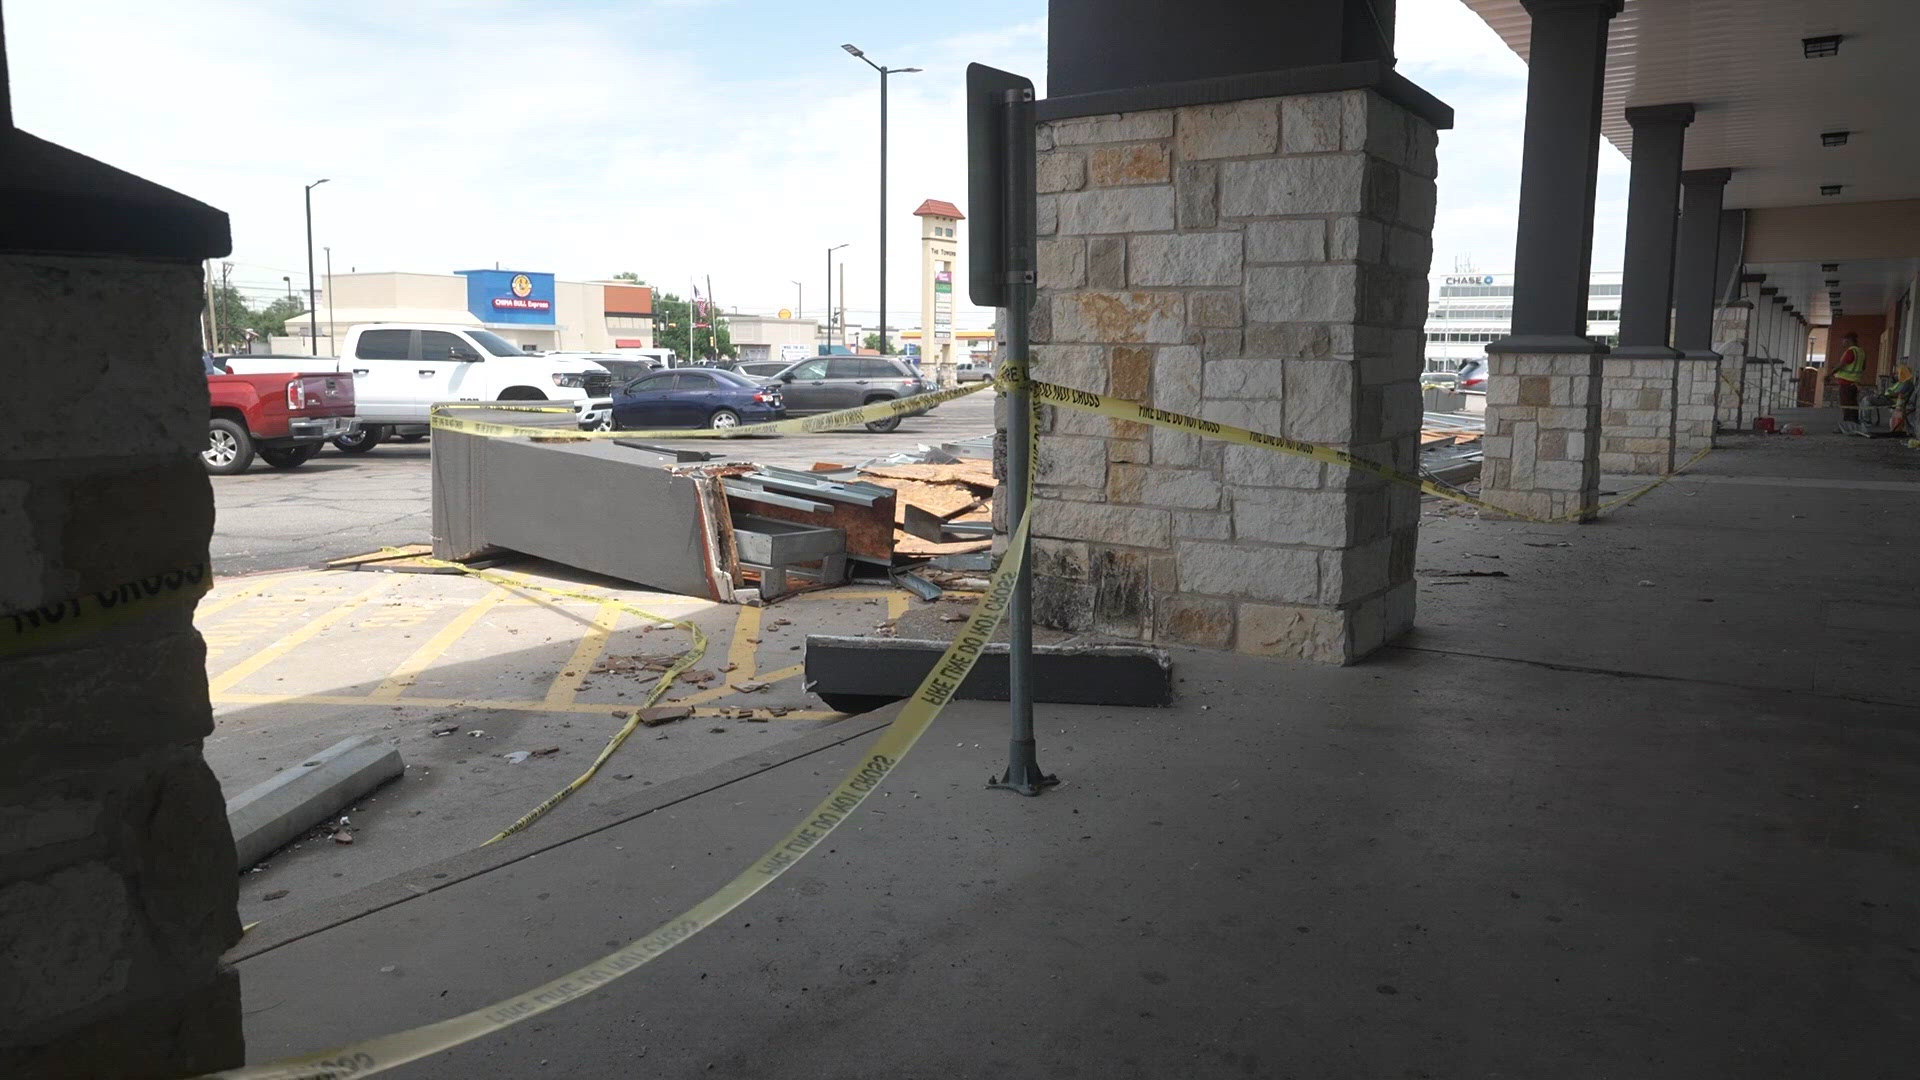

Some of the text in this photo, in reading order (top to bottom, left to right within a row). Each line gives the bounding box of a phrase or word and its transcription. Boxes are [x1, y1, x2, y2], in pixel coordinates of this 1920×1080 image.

[1445, 276, 1481, 285] CHASE
[494, 299, 513, 307] CHINA
[528, 301, 549, 309] Express
[1053, 384, 1071, 402] NOT
[1072, 389, 1100, 408] CROSS
[1138, 405, 1220, 434] FIRE LINE DO NOT CROSS
